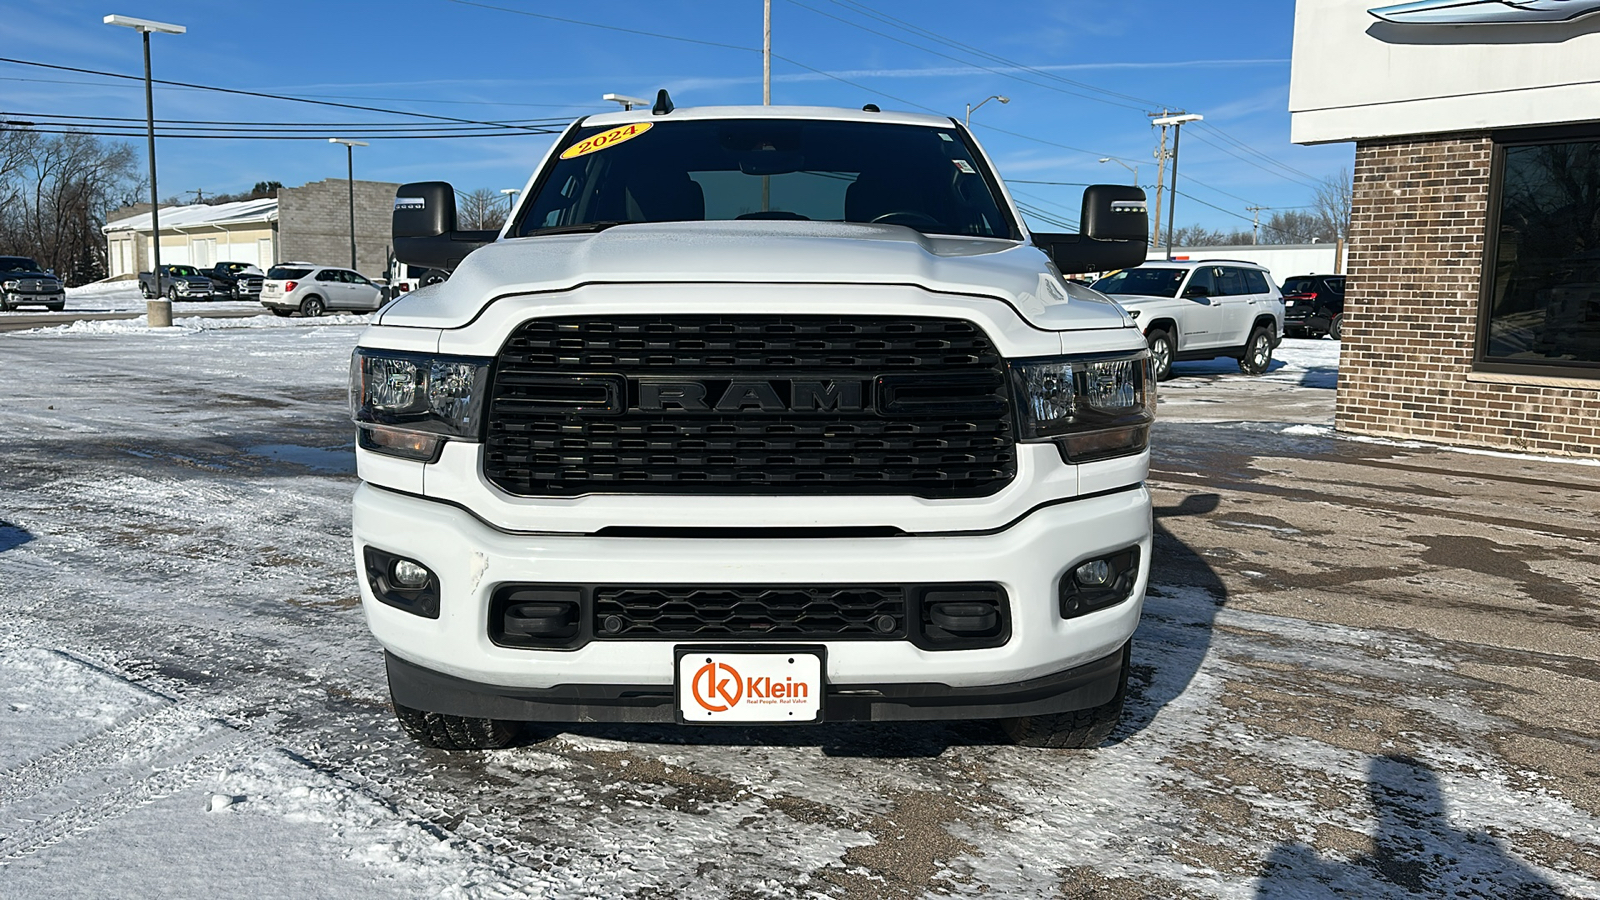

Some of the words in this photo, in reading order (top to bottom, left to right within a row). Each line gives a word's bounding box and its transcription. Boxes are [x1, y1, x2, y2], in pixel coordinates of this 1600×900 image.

[578, 125, 639, 154] 2024
[638, 378, 863, 410] RAM
[747, 676, 808, 699] Klein
